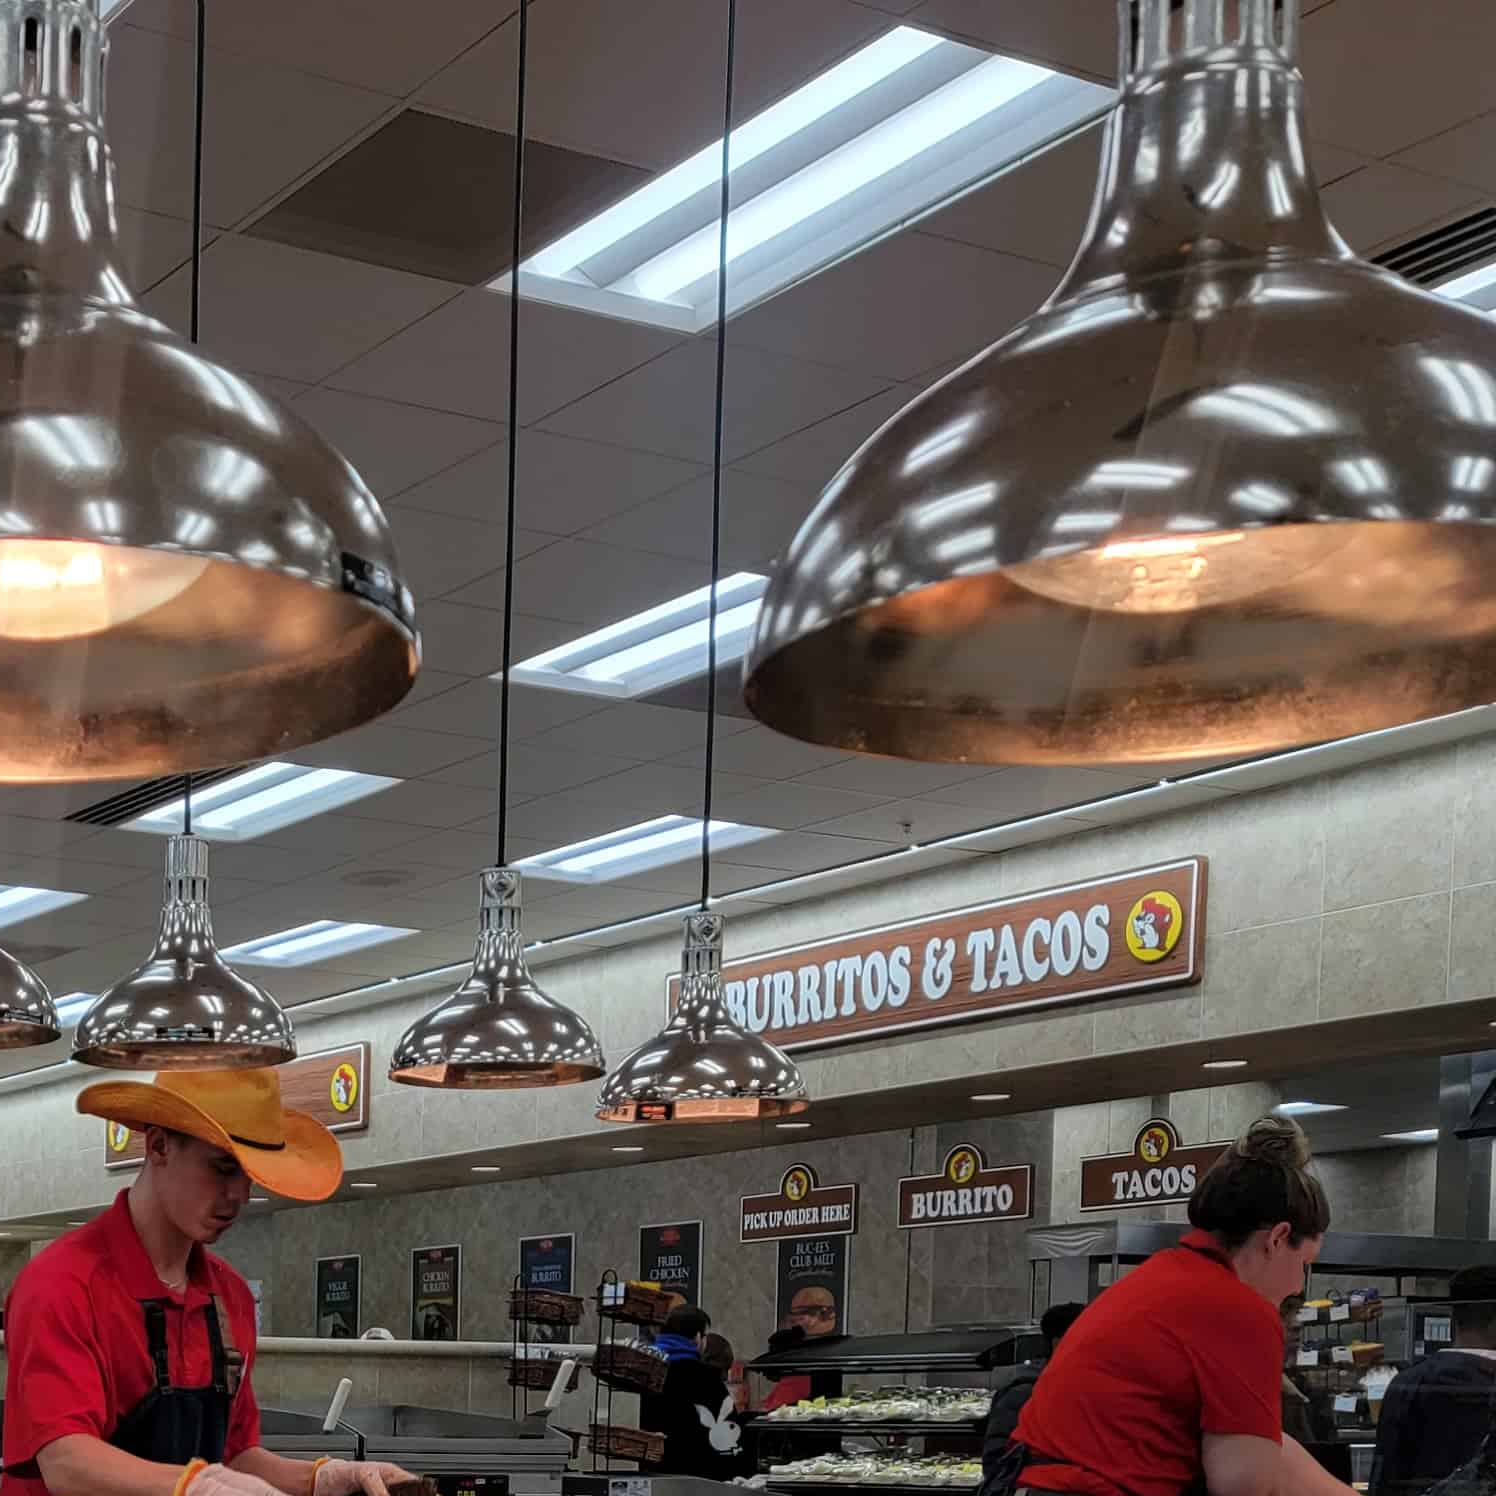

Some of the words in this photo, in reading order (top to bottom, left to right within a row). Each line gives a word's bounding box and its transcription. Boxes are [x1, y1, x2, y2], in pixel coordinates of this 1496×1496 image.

[725, 945, 911, 1034] BURRITOS
[922, 936, 954, 1000] &
[967, 903, 1111, 993] TACOS
[1112, 1164, 1197, 1200] TACOS
[744, 1211, 768, 1231] PICK
[769, 1210, 784, 1228] UP
[784, 1207, 820, 1227] ORDER
[821, 1203, 851, 1223] HERE
[912, 1184, 1014, 1219] BURRITO
